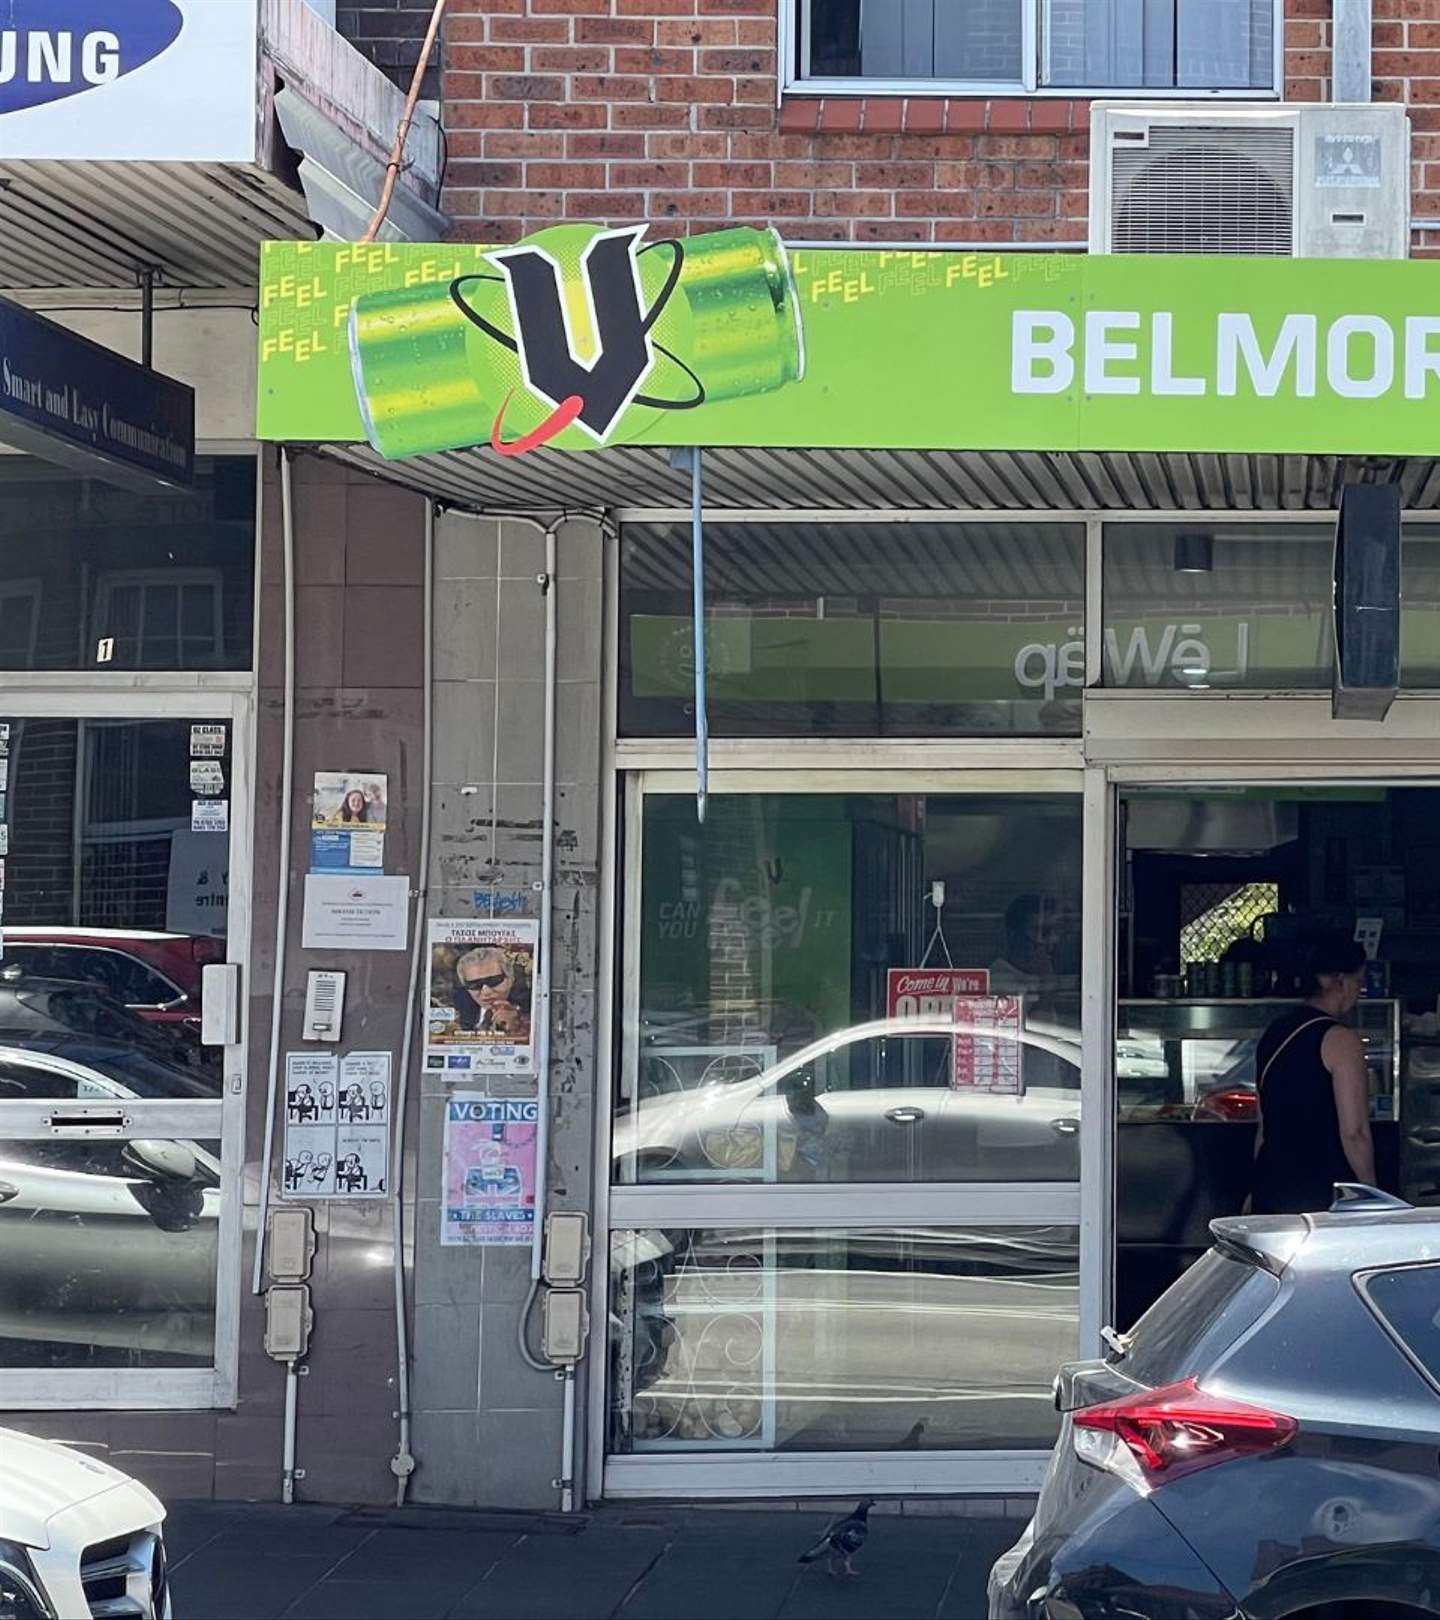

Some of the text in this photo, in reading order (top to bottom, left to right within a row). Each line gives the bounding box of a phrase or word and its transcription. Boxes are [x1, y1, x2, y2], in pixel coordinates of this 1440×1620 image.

[811, 271, 875, 303] FEEL
[945, 255, 1009, 288] FEEL
[263, 274, 328, 308] FEEL
[262, 328, 327, 362] FEEL
[3, 356, 42, 409] Smart
[46, 384, 69, 420] and
[896, 975, 934, 994] Come
[456, 1103, 538, 1120] VOTING
